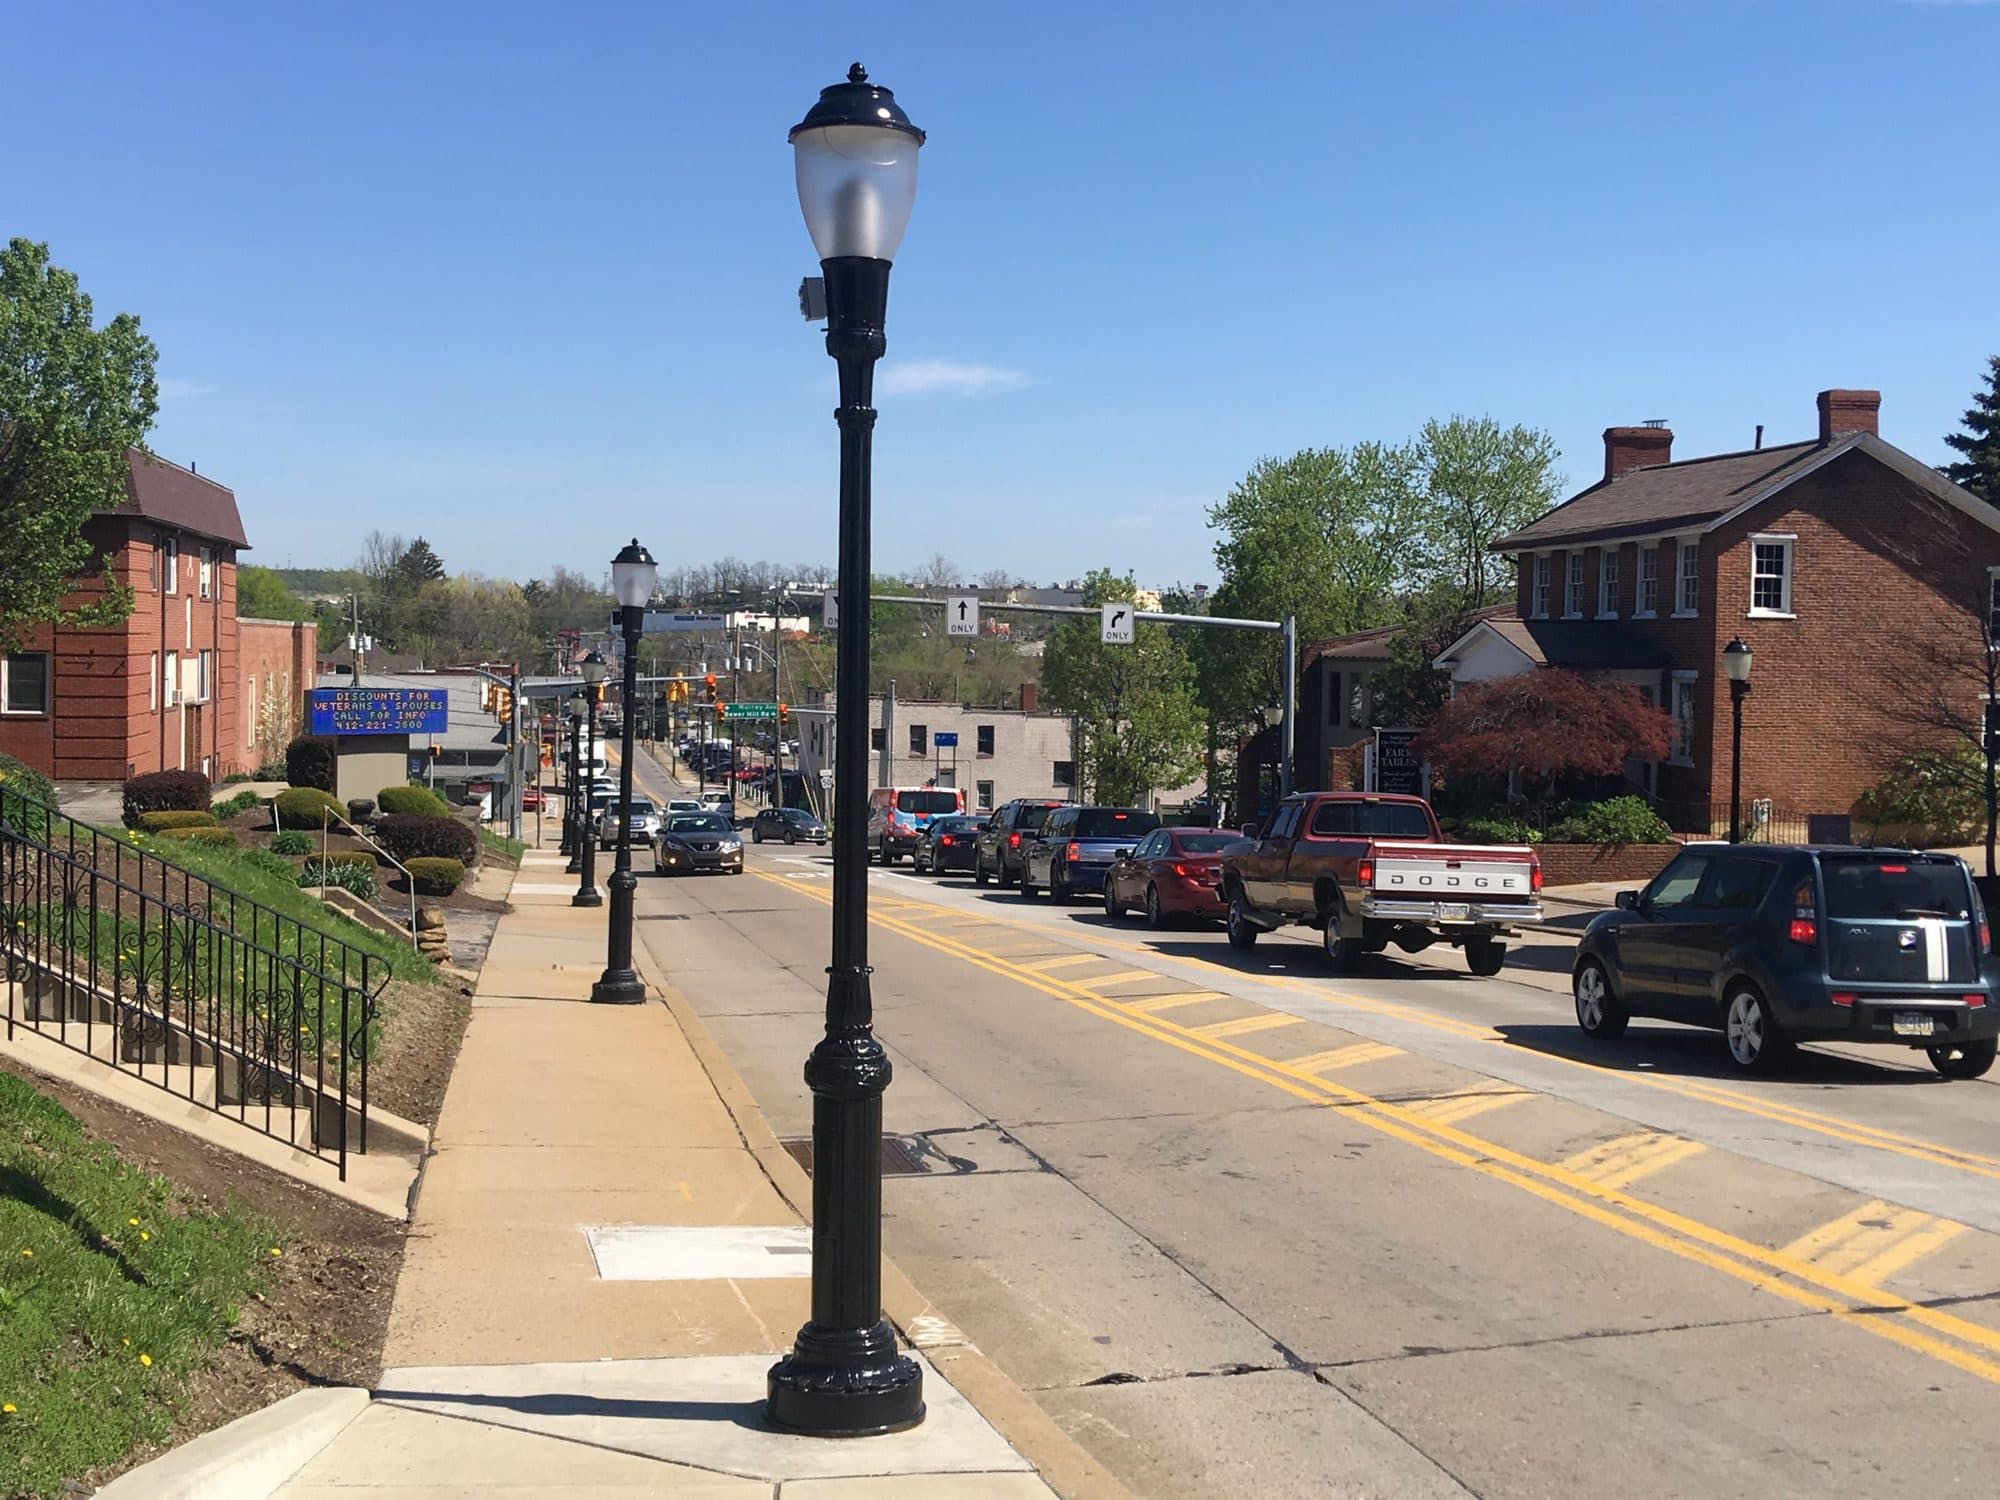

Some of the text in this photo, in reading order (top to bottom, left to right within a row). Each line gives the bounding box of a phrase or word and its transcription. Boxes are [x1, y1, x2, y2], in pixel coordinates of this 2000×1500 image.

[951, 624, 974, 633] ONLY
[1106, 631, 1129, 640] ONLY
[336, 692, 430, 701] DISCOUNTS FOR
[314, 702, 373, 711] VETERANS
[395, 702, 443, 710] SPOUSES
[333, 711, 426, 720] CALL FOR INFO
[1391, 875, 1516, 889] DODGE
